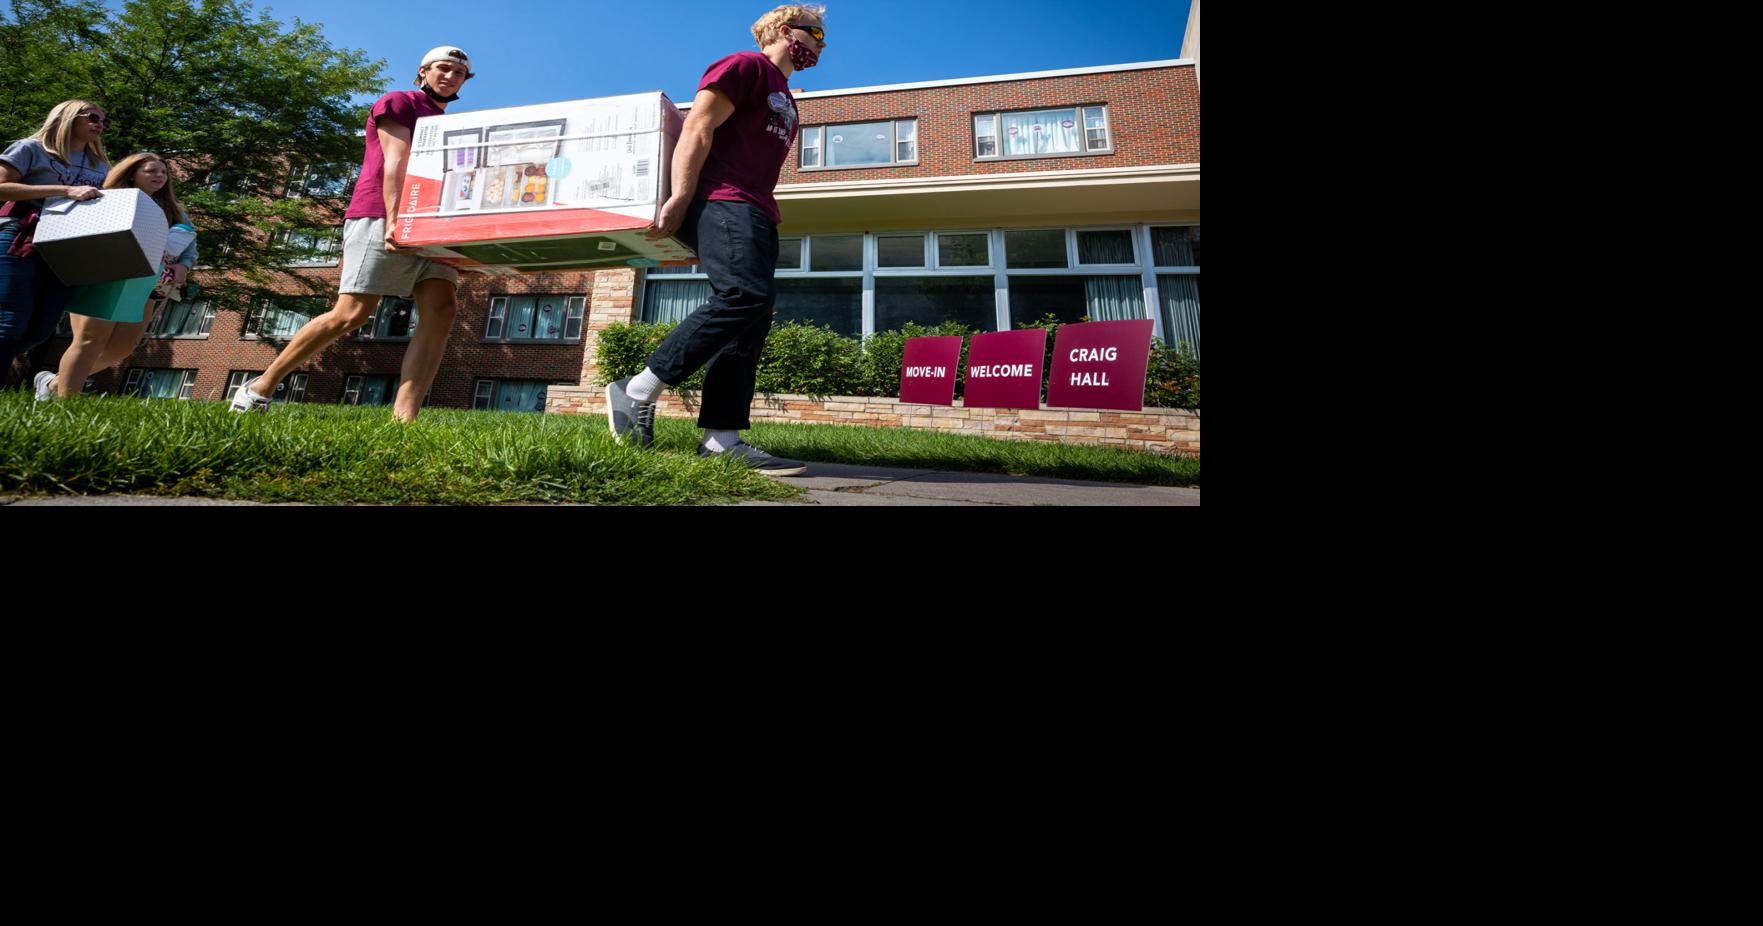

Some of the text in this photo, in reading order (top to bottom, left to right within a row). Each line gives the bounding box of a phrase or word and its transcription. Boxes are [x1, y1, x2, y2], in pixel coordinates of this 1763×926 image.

[401, 183, 421, 240] FRIGDAIRE
[1069, 346, 1118, 362] CRAIG
[905, 366, 946, 378] MOVE-IN
[970, 364, 1033, 378] WELCOME
[1070, 371, 1109, 386] HALL
